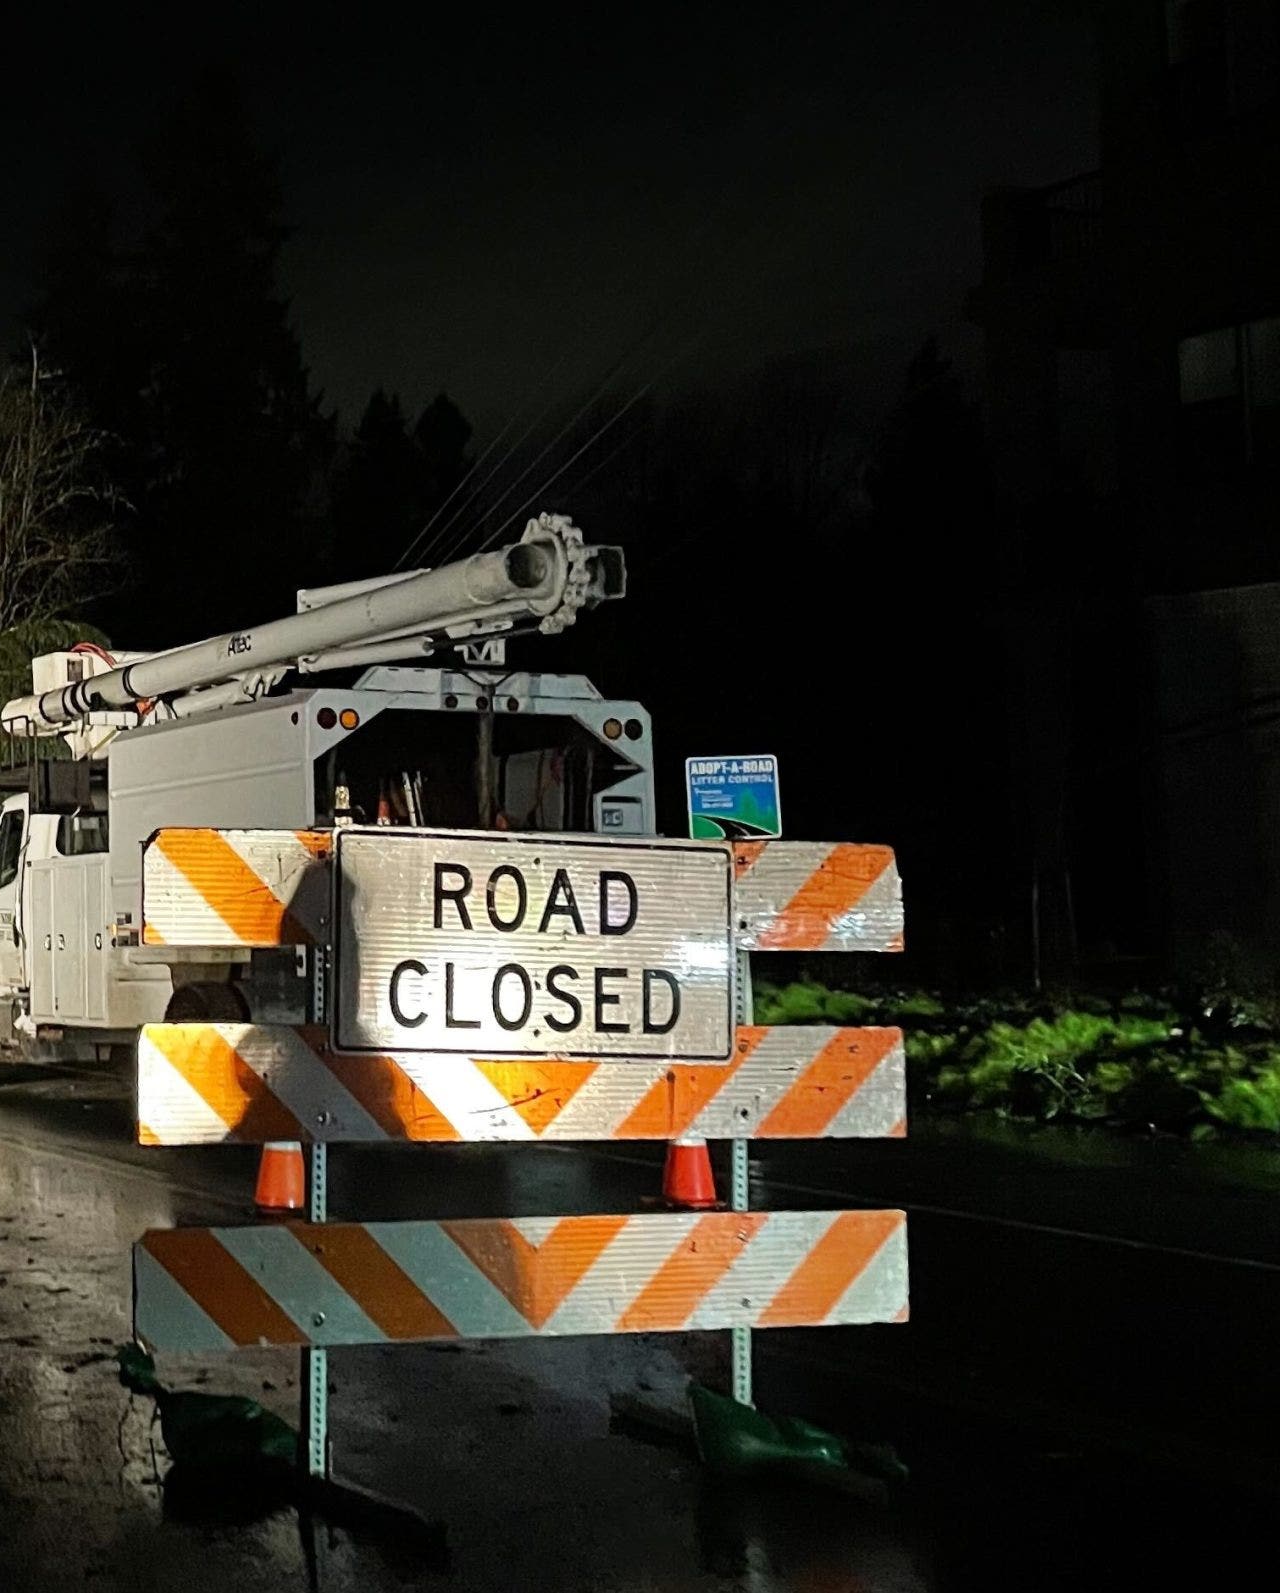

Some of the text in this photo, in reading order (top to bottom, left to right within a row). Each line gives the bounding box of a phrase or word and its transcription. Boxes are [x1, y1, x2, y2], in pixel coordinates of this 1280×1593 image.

[690, 760, 774, 775] ADOPT-A-ROAD
[691, 774, 774, 786] LITTER CONTROL
[433, 861, 639, 936] ROAD
[388, 958, 682, 1035] CLOSED
